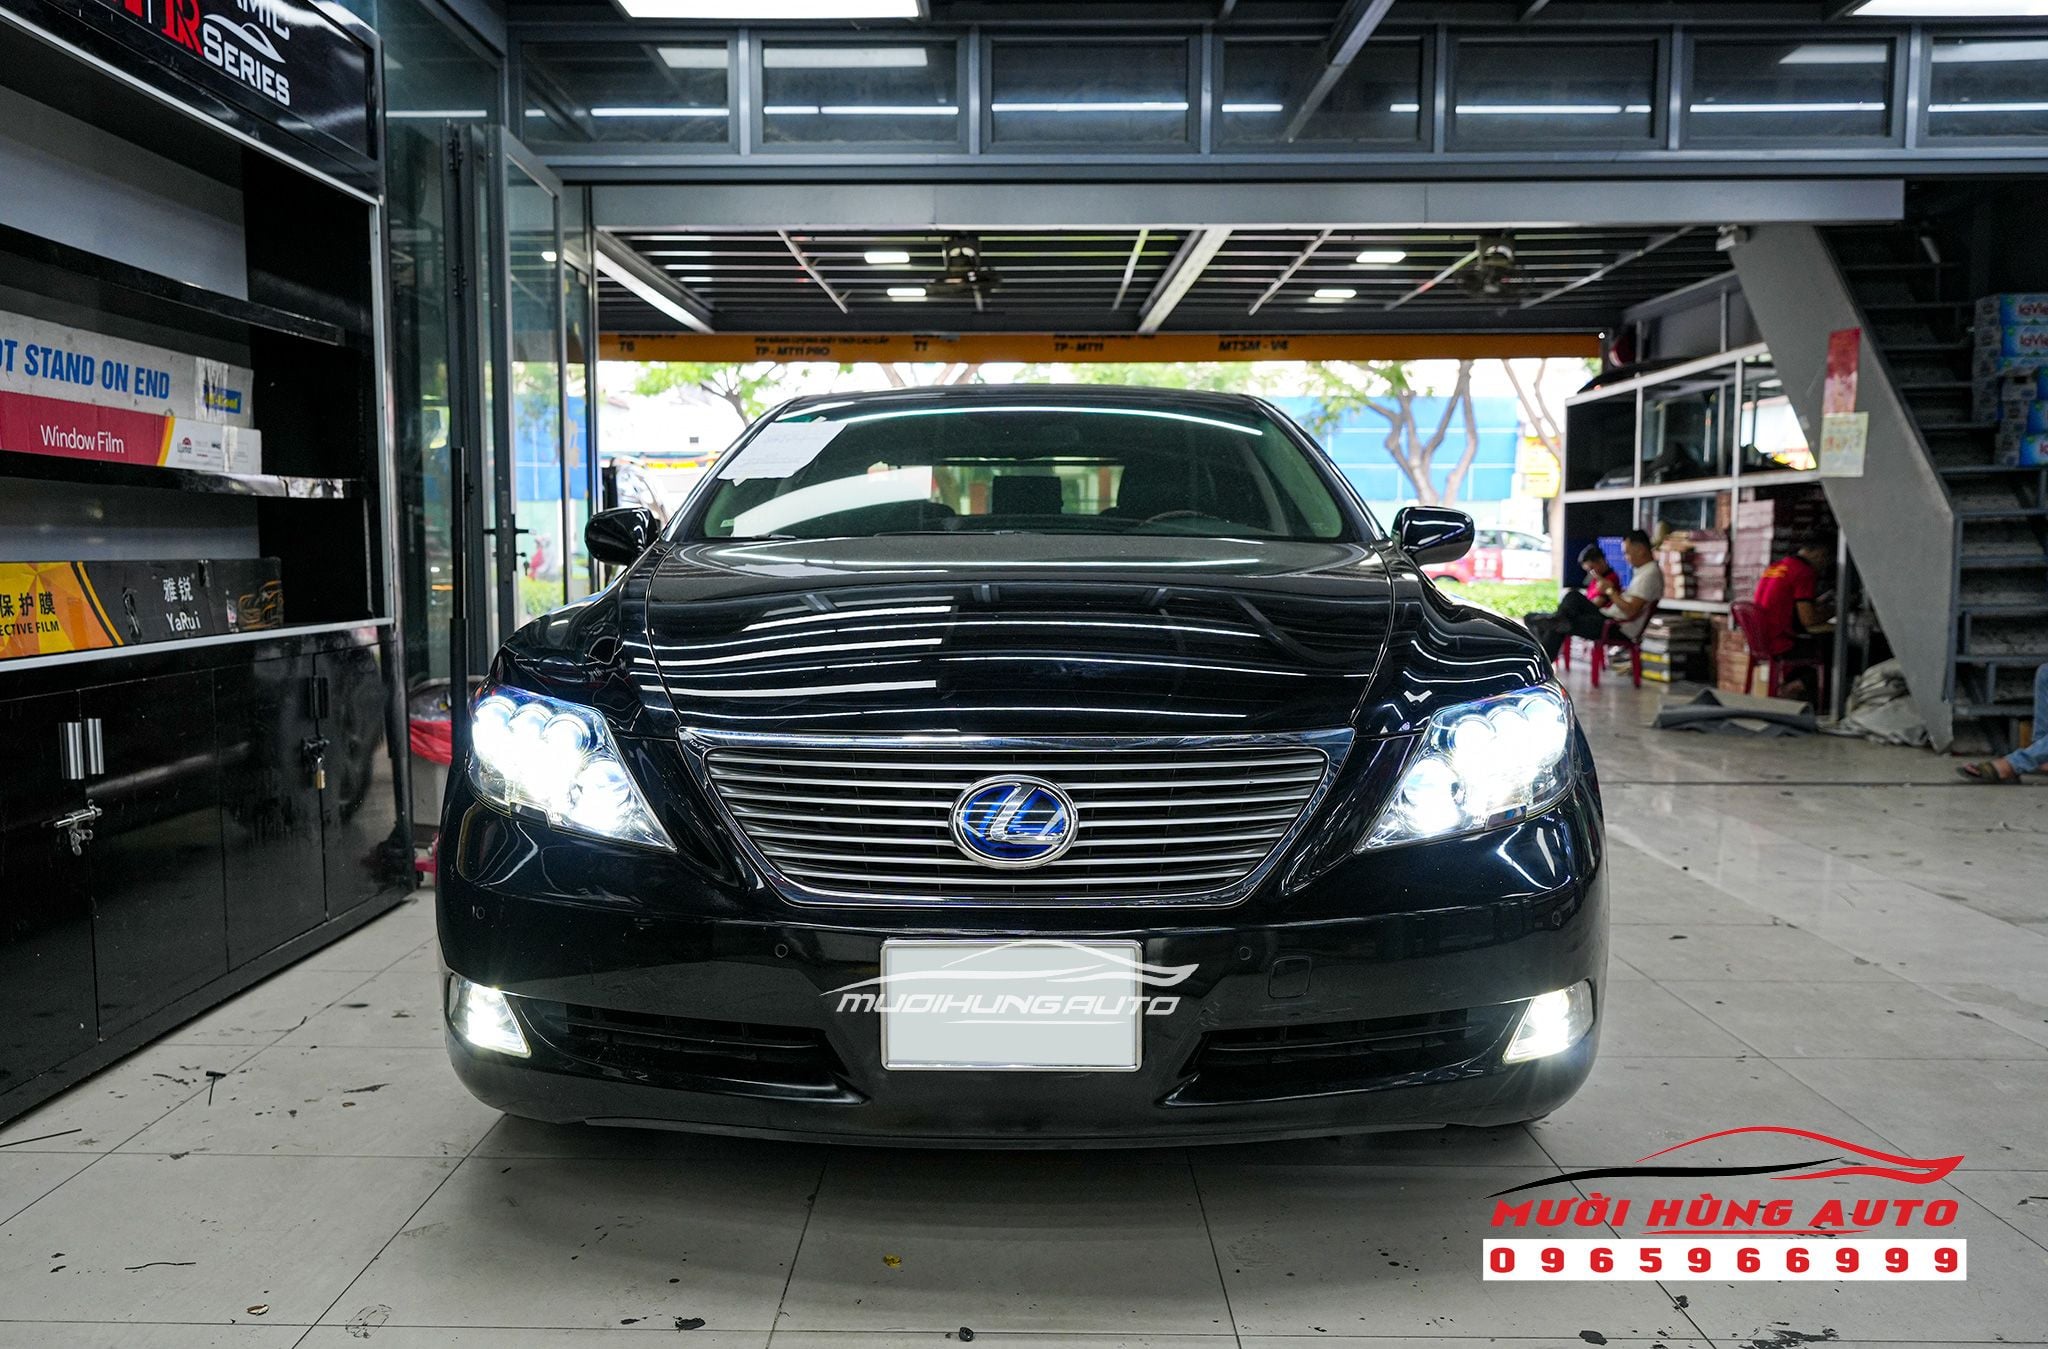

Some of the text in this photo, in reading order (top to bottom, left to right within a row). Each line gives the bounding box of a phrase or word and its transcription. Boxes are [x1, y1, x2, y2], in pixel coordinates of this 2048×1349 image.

[202, 22, 290, 106] SERIES
[806, 346, 830, 355] PRO
[25, 344, 95, 386] STAND
[101, 360, 129, 393] ON
[134, 366, 170, 400] END
[40, 425, 125, 454] Window Film
[163, 576, 194, 602] 雅锐
[0, 592, 56, 618] 保护膜
[35, 621, 60, 633] FILM
[166, 611, 202, 633] YaRui
